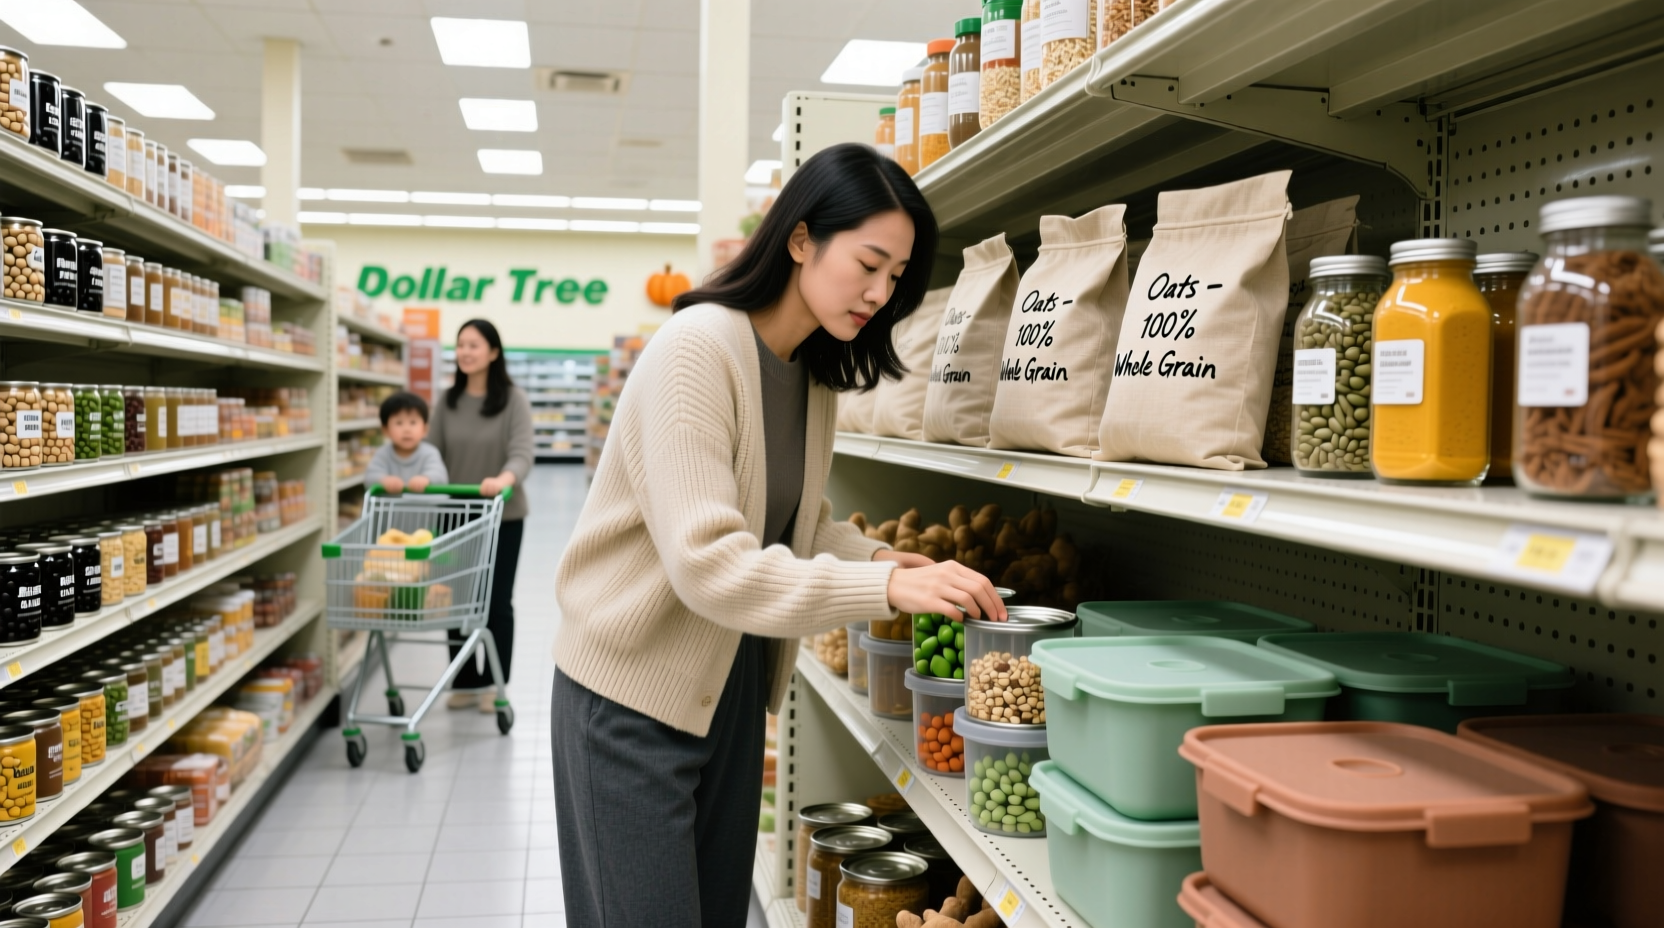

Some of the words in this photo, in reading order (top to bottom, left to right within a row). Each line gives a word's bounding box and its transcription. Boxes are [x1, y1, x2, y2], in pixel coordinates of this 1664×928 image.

[357, 266, 495, 300] Dollar
[508, 269, 609, 305] Tree
[1147, 272, 1200, 301] Oats
[1022, 289, 1060, 313] Oats
[1015, 320, 1056, 349] 100%
[1140, 308, 1198, 341] 100%
[1024, 356, 1069, 384] Grain
[1114, 350, 1153, 378] Whole
[1158, 350, 1217, 380] Grain
